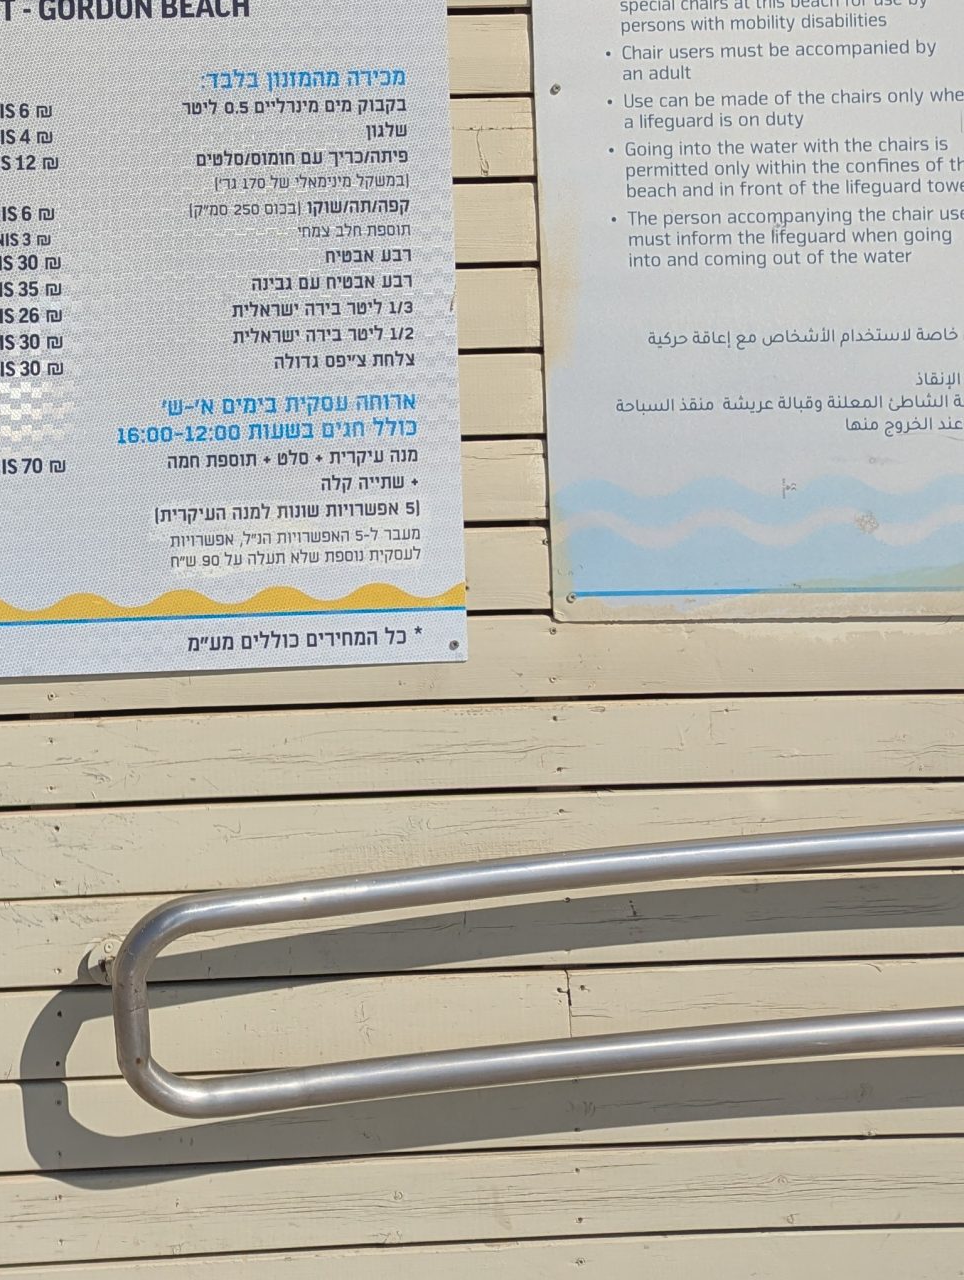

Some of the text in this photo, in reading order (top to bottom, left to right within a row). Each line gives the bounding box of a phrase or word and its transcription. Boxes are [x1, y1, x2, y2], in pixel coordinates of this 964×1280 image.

[200, 69, 407, 92] מכירה מהמזנון בלבד:
[622, 65, 692, 81] an adult
[18, 103, 30, 119] 6
[182, 97, 407, 116] בקבוק מים מינרליים 0.5 ליטר
[366, 122, 407, 140] שלגון
[16, 156, 36, 170] 12
[629, 227, 952, 247] must inform the lifeguard when going
[325, 249, 412, 263] רבע אבטיח
[18, 281, 39, 297] 35
[274, 353, 319, 369] גדולה
[373, 351, 415, 367] צלחת
[223, 396, 278, 414] בימים
[285, 394, 349, 416] עסקית
[356, 393, 417, 411] ארוחה
[248, 421, 314, 440] בשעות
[322, 420, 365, 438] חגים
[373, 417, 418, 436] כולל
[22, 459, 43, 474] 70
[188, 633, 234, 652] מע"מ
[241, 631, 299, 649] כוללים
[306, 628, 378, 647] המחירים
[384, 626, 407, 645] כל
